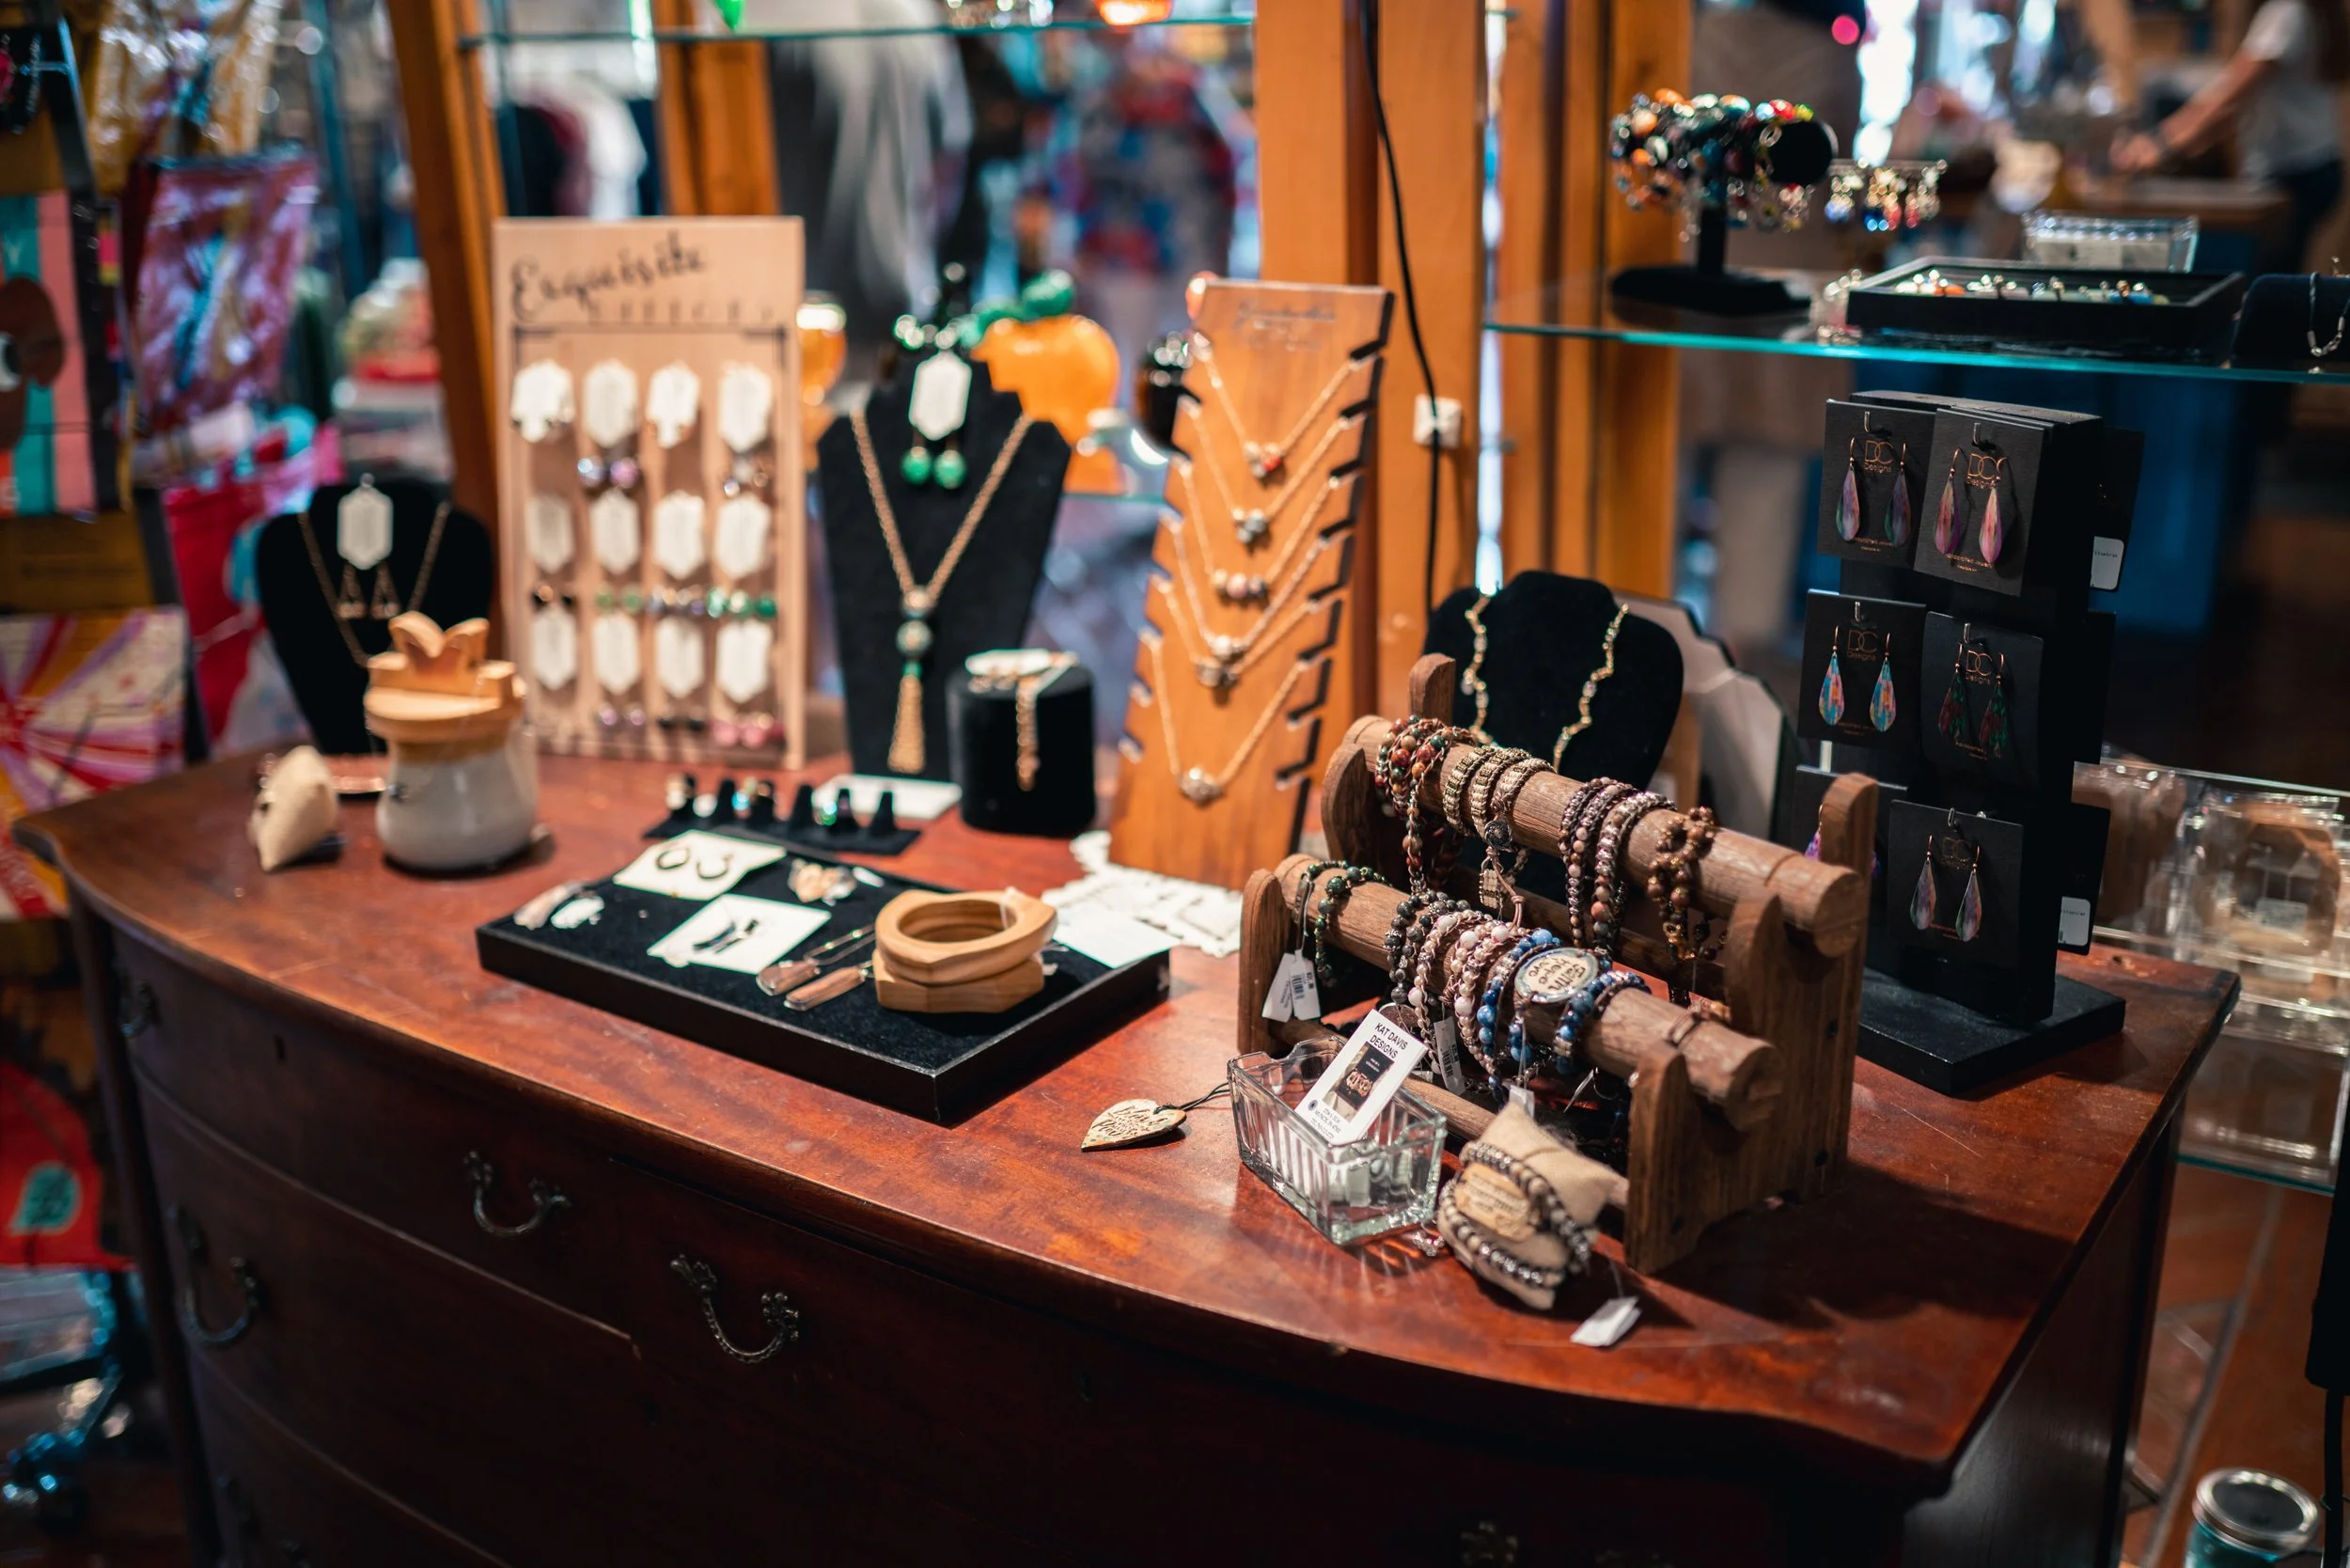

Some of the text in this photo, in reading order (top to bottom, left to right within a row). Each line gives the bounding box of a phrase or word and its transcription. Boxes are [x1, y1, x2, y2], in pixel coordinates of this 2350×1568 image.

[1864, 440, 1894, 465] DC
[1967, 453, 1998, 480] DC
[1847, 629, 1878, 653] DC
[1966, 650, 1993, 677] DC
[1369, 1035, 1399, 1059] DESIGNS
[1374, 1022, 1408, 1051] KAT DAVIS
